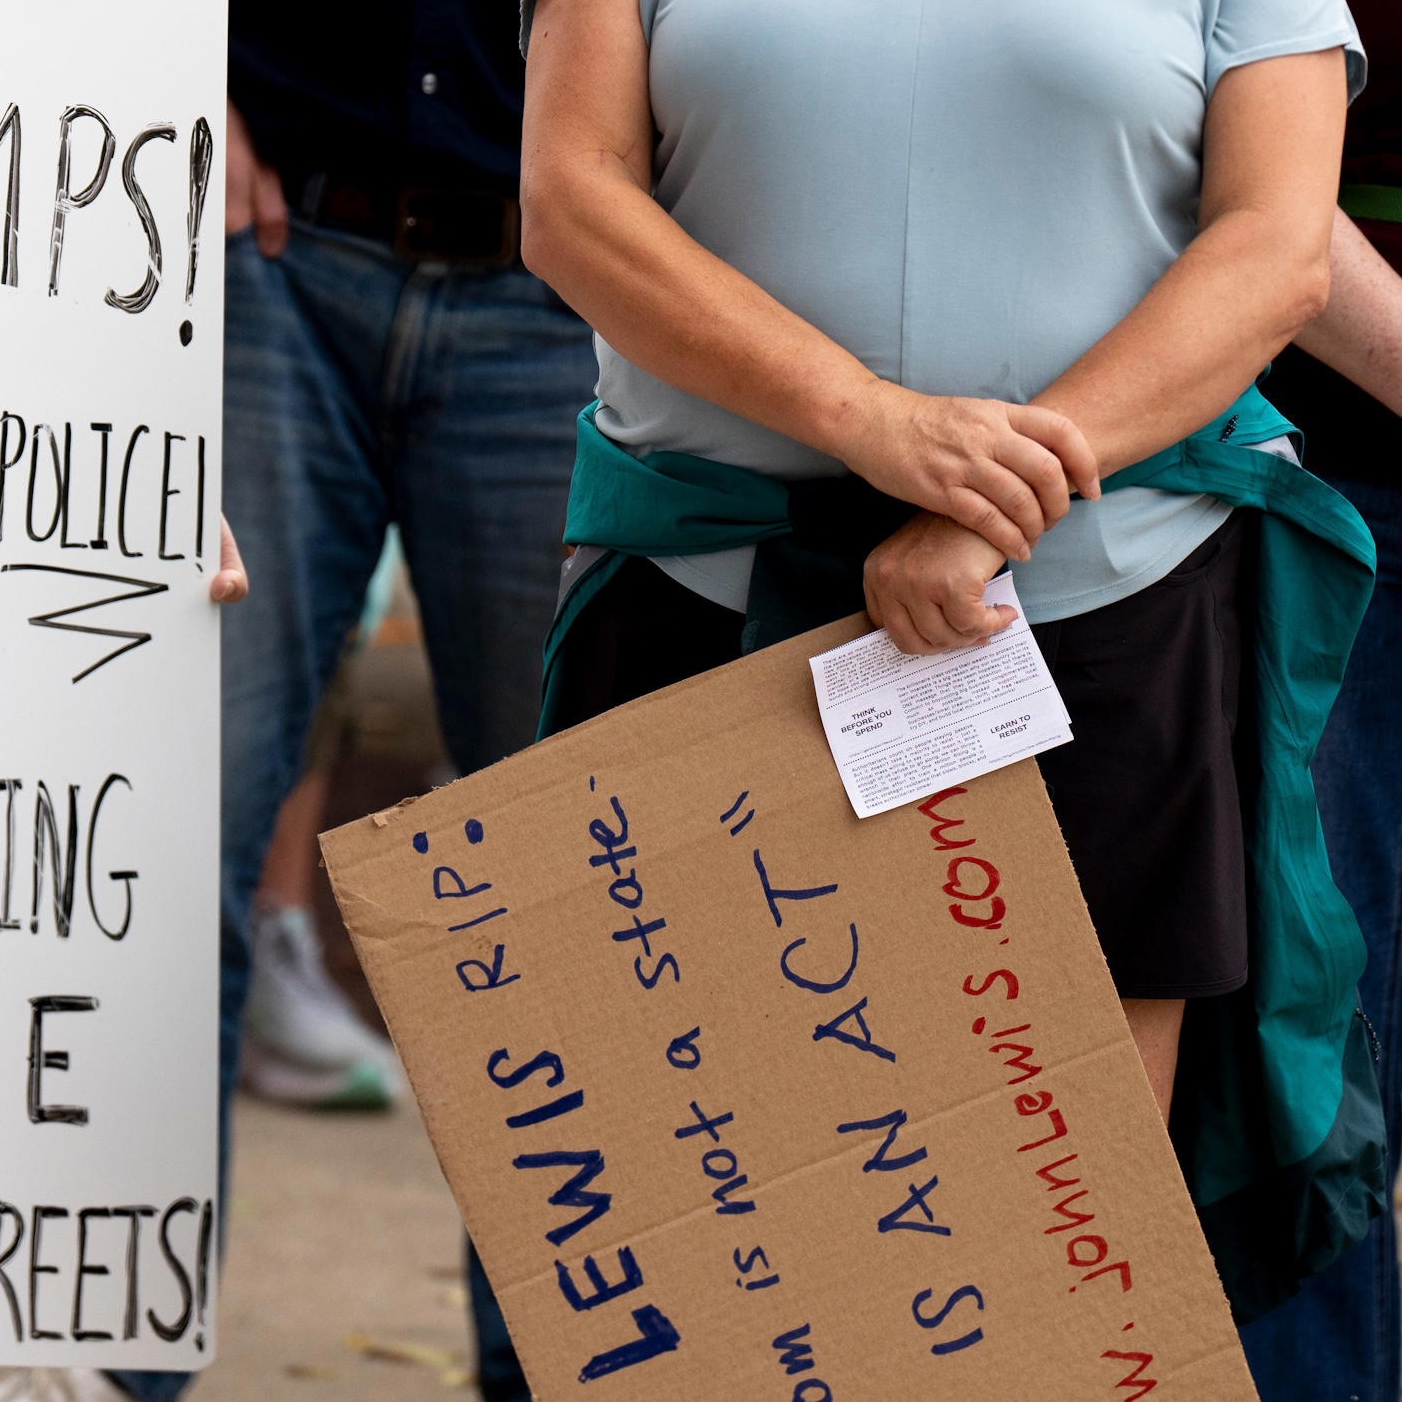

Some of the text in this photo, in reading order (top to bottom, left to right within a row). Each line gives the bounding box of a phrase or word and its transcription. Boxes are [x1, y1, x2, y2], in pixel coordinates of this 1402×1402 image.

[841, 709, 892, 733] BEFORE YOU
[852, 707, 876, 720] THINK
[855, 722, 883, 736] SPEND
[990, 714, 1031, 734] LEARN TO
[999, 724, 1028, 739] RESIST
[720, 790, 896, 1063] ACT"
[666, 1026, 701, 1070] a
[412, 818, 681, 1383] LEWIS RIP:
[674, 1100, 756, 1216] not
[836, 1109, 952, 1236] AN
[733, 1245, 780, 1291] is
[912, 1284, 984, 1356] IS
